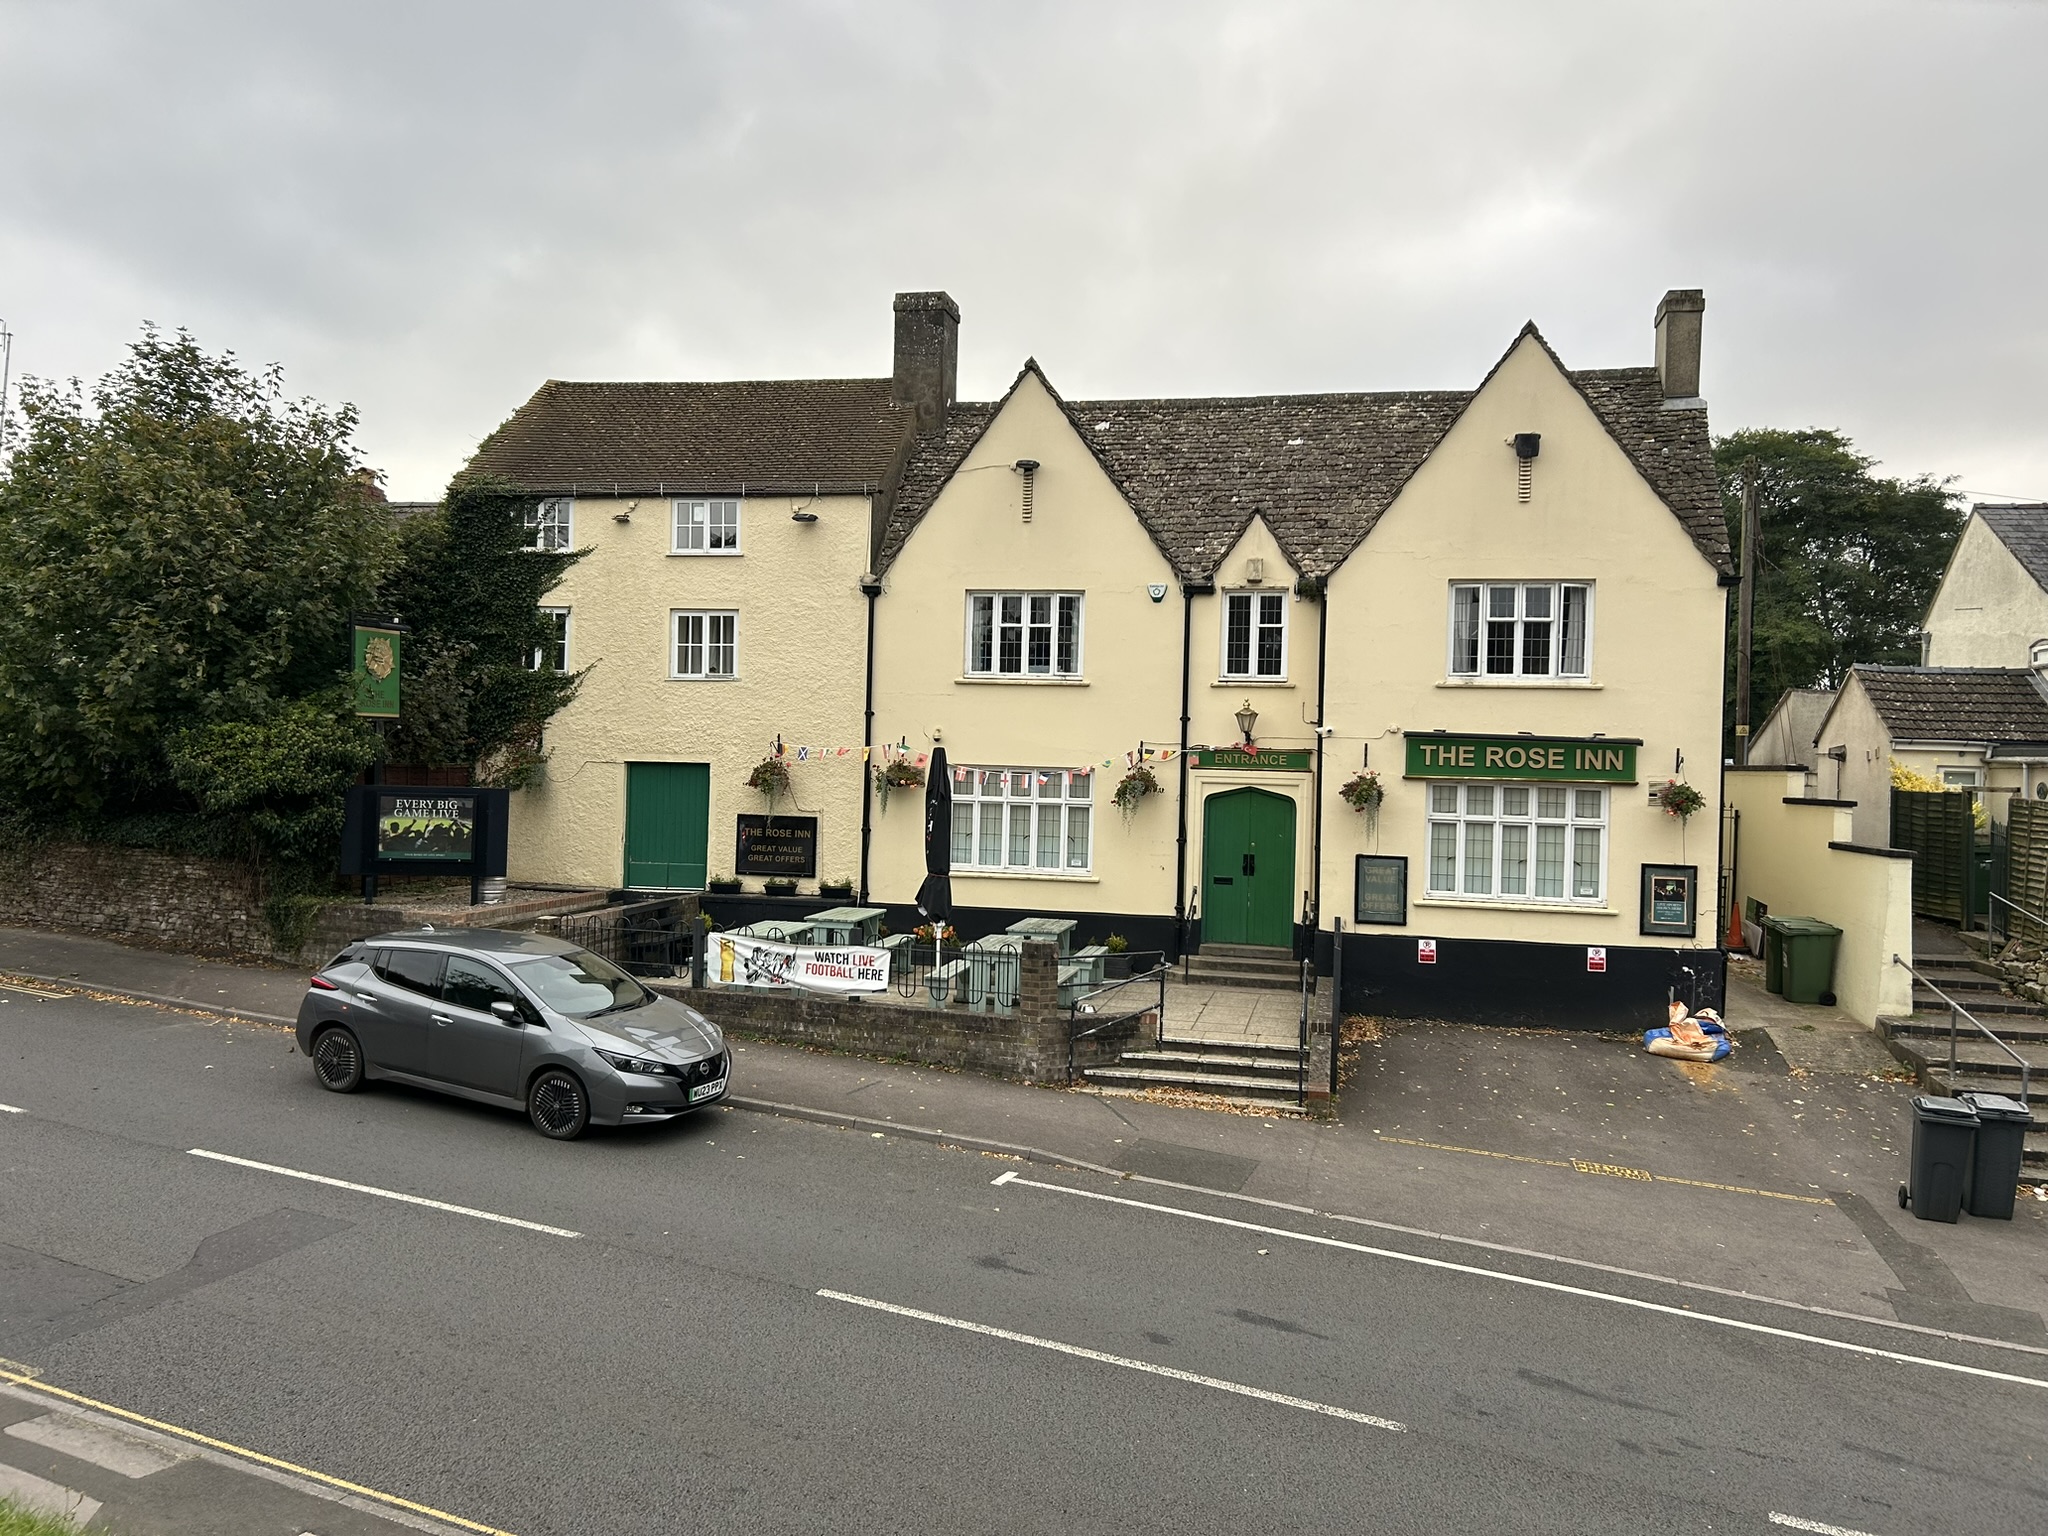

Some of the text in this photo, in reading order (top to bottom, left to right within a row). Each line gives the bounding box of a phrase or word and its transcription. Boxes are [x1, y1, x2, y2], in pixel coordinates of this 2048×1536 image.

[1214, 753, 1287, 766] ENTRANCE
[1420, 744, 1624, 771] THE ROSE INN
[396, 799, 458, 810] EVERY BIG
[393, 808, 459, 819] GAME LIVE
[745, 827, 811, 839] THE ROSE INN
[751, 844, 777, 852] GREAT
[747, 854, 806, 864] GREAT OFFERS
[1365, 867, 1398, 875] GREAT
[1365, 875, 1397, 883] VALUE
[1361, 902, 1399, 910] OFFERS
[814, 951, 875, 967] WATCH LIVE
[805, 963, 884, 981] FOOTBALL HERE
